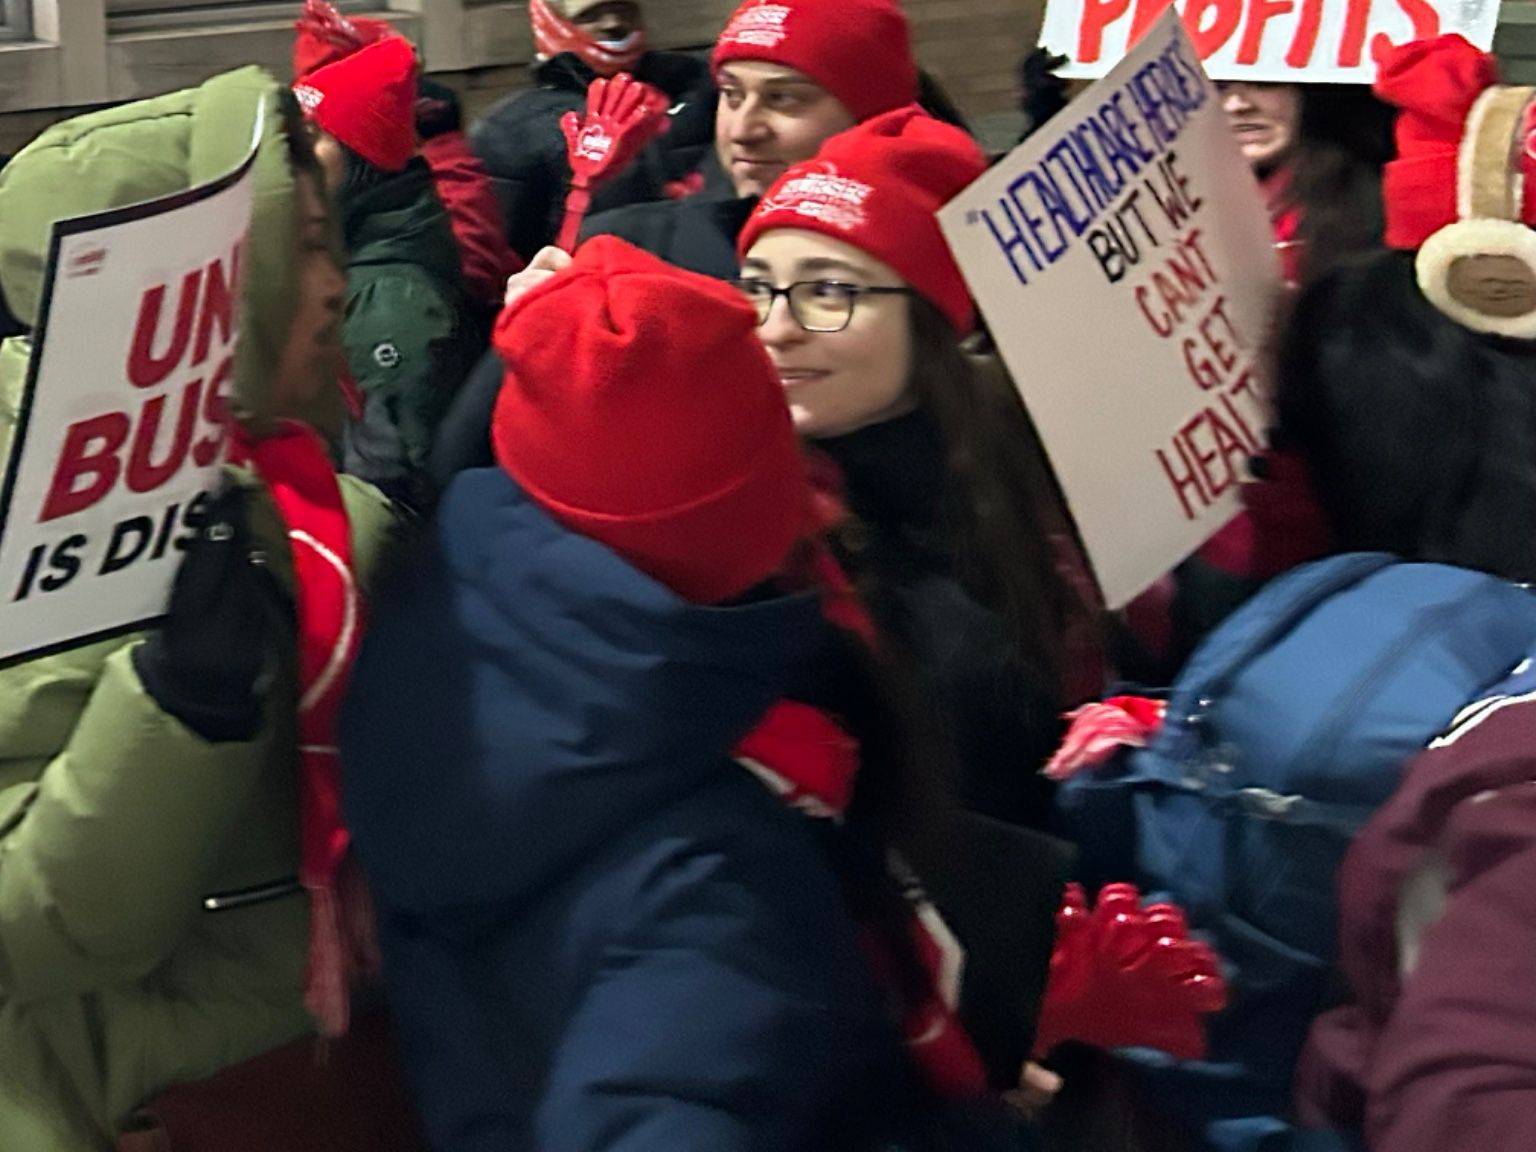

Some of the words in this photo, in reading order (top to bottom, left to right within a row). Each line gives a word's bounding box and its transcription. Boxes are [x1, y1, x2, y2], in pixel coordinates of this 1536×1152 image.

[1086, 189, 1161, 284] BUT
[1144, 150, 1203, 230] WE
[1183, 296, 1243, 391] GET
[13, 533, 88, 602] IS
